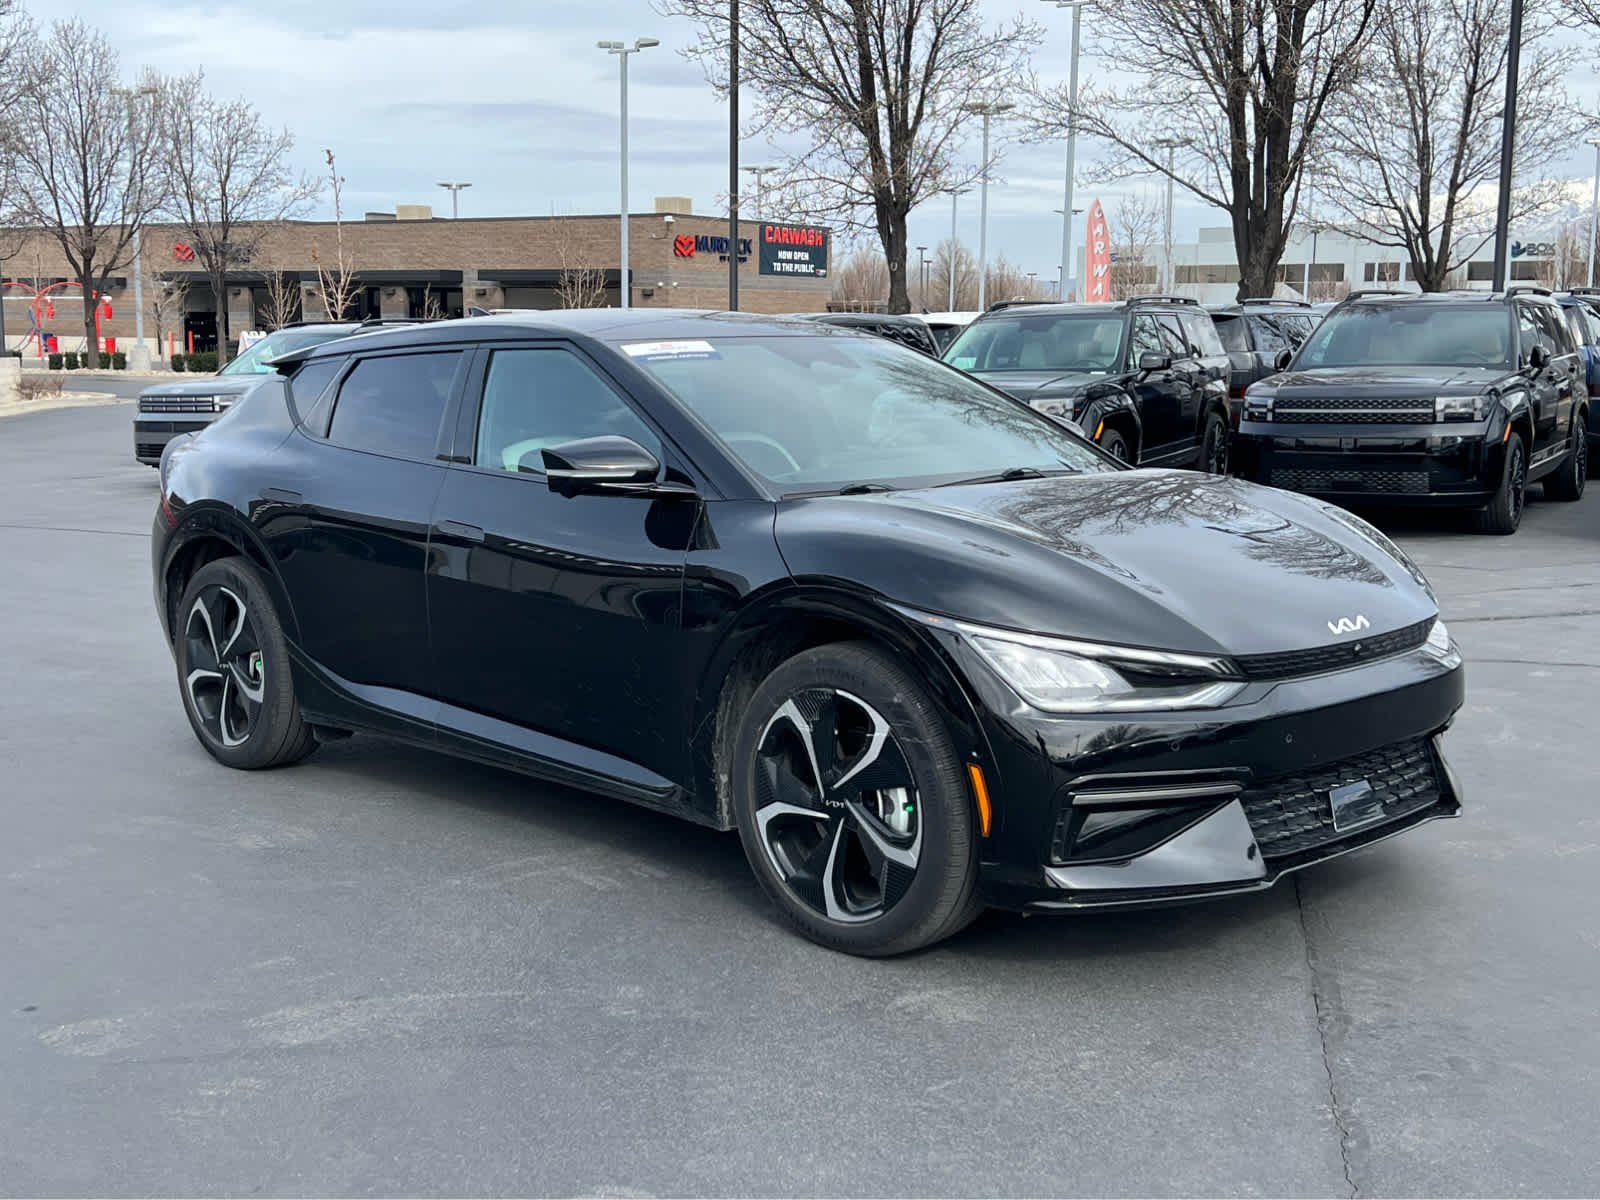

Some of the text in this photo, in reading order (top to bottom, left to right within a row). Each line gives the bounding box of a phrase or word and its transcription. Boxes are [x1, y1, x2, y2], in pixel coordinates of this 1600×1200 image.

[765, 225, 823, 247] CARWASH
[695, 235, 752, 255] MURDCK
[778, 250, 809, 260] NOW OPEN
[773, 262, 781, 271] TO
[782, 263, 793, 272] THE
[794, 263, 815, 273] PUBLIC
